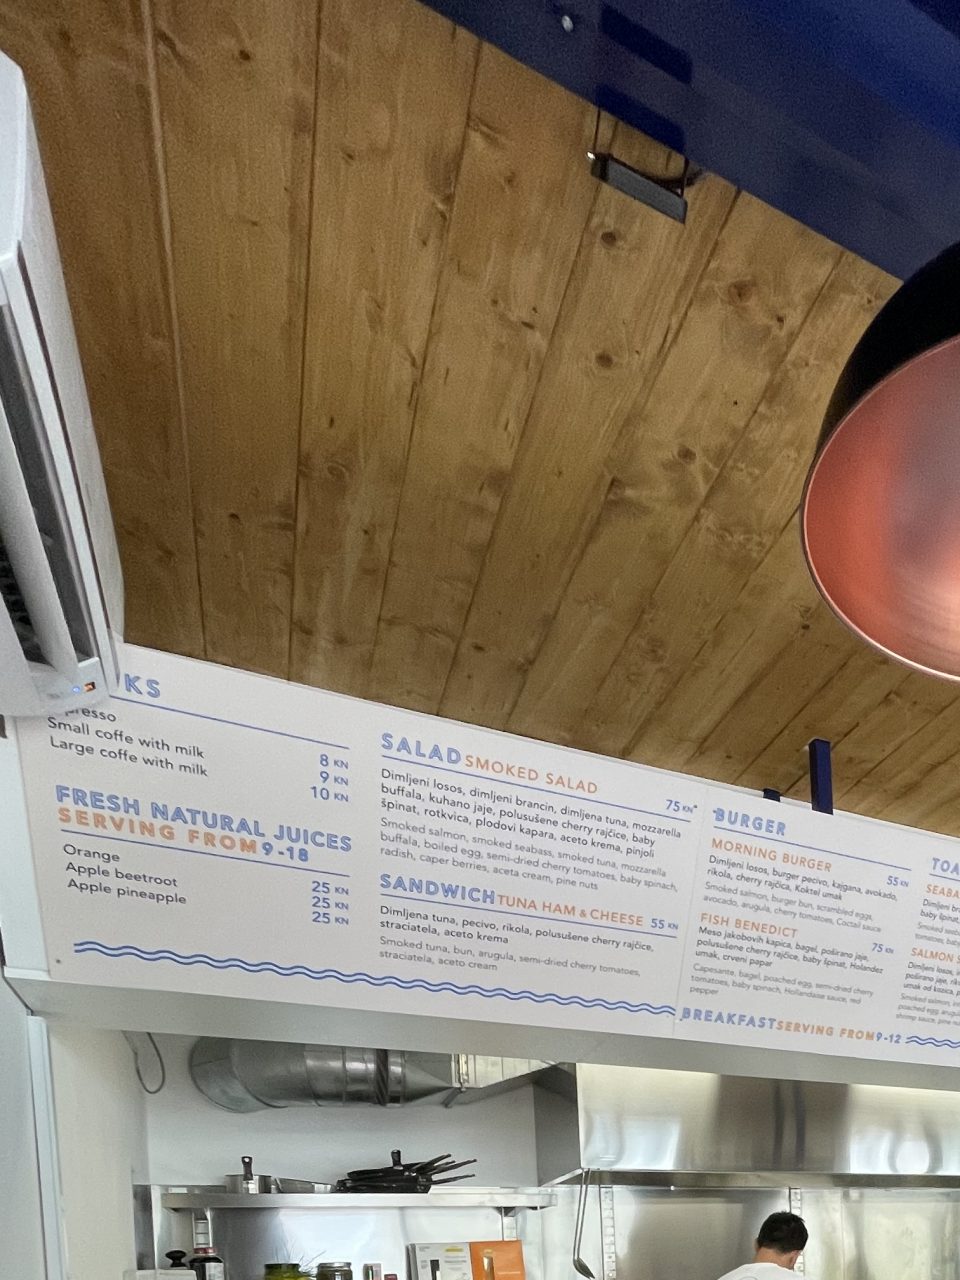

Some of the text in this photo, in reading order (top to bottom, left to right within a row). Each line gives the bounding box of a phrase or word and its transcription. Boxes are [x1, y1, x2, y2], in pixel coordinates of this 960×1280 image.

[47, 714, 204, 759] Small coffe with milk
[50, 735, 207, 776] Large coffe with milk
[319, 753, 329, 767] 8
[381, 732, 597, 794] SALAD SMOKED SALAD
[319, 770, 329, 783] 9
[310, 786, 329, 800] 10
[381, 768, 681, 838] Dimljeni losos, dimljeni brancin, dimljena tuna, mozzarella
[666, 799, 680, 812] 75
[55, 785, 351, 852] FRESH NATURAL JUICES
[58, 807, 174, 840] SERVING
[188, 829, 256, 854] FROM
[381, 782, 425, 802] buffala,
[429, 791, 470, 810] kuhano
[472, 801, 495, 816] jaje,
[499, 809, 558, 827] polusušene
[561, 819, 593, 836] cherry
[631, 832, 655, 848] baby
[381, 797, 654, 858] špinat, rotkvica, plodovi kapara, aceto krema, pinjoli
[715, 807, 785, 836] BURGER
[63, 843, 120, 863] Orange
[380, 816, 666, 877] Smoked salmon, smoked seabass, smoked tuna, mozzarella
[380, 830, 678, 892] buffala, boiled egg, semi-dried cherry tomatoes, baby spinach,
[711, 837, 832, 872] MORNING BURGER
[65, 861, 177, 887] Apple beetroot
[380, 847, 416, 861] radish,
[419, 854, 449, 865] caper
[451, 856, 489, 873] berries,
[521, 872, 553, 884] cream,
[555, 877, 576, 886] pine
[579, 881, 598, 890] nuts
[707, 867, 733, 880] rikola,
[735, 872, 762, 887] cherry
[822, 892, 842, 900] umak
[708, 854, 744, 869] Dimljeni
[746, 861, 769, 876] losos,
[772, 867, 800, 881] burger
[801, 875, 829, 888] pecivo,
[886, 875, 899, 886] 55
[67, 878, 186, 905] Apple pineapple
[311, 880, 330, 894] 25
[312, 895, 330, 909] 25
[379, 873, 643, 926] SANDWICH TUNA HAM & CHEESE
[312, 911, 330, 924] 25
[379, 920, 508, 944] straciatela, aceto krema
[380, 905, 428, 920] Dimljena
[432, 914, 458, 926] tuna,
[461, 919, 498, 931] pecivo,
[502, 923, 532, 936] rikola,
[535, 929, 589, 942] polusušene
[591, 935, 621, 949] cherry
[650, 918, 665, 929] 55
[700, 912, 797, 938] FISH BENEDICT
[871, 942, 884, 953] 75
[911, 947, 954, 962] SALMON
[682, 1007, 902, 1044] BREAKFAST SERVING FROM 9-12
